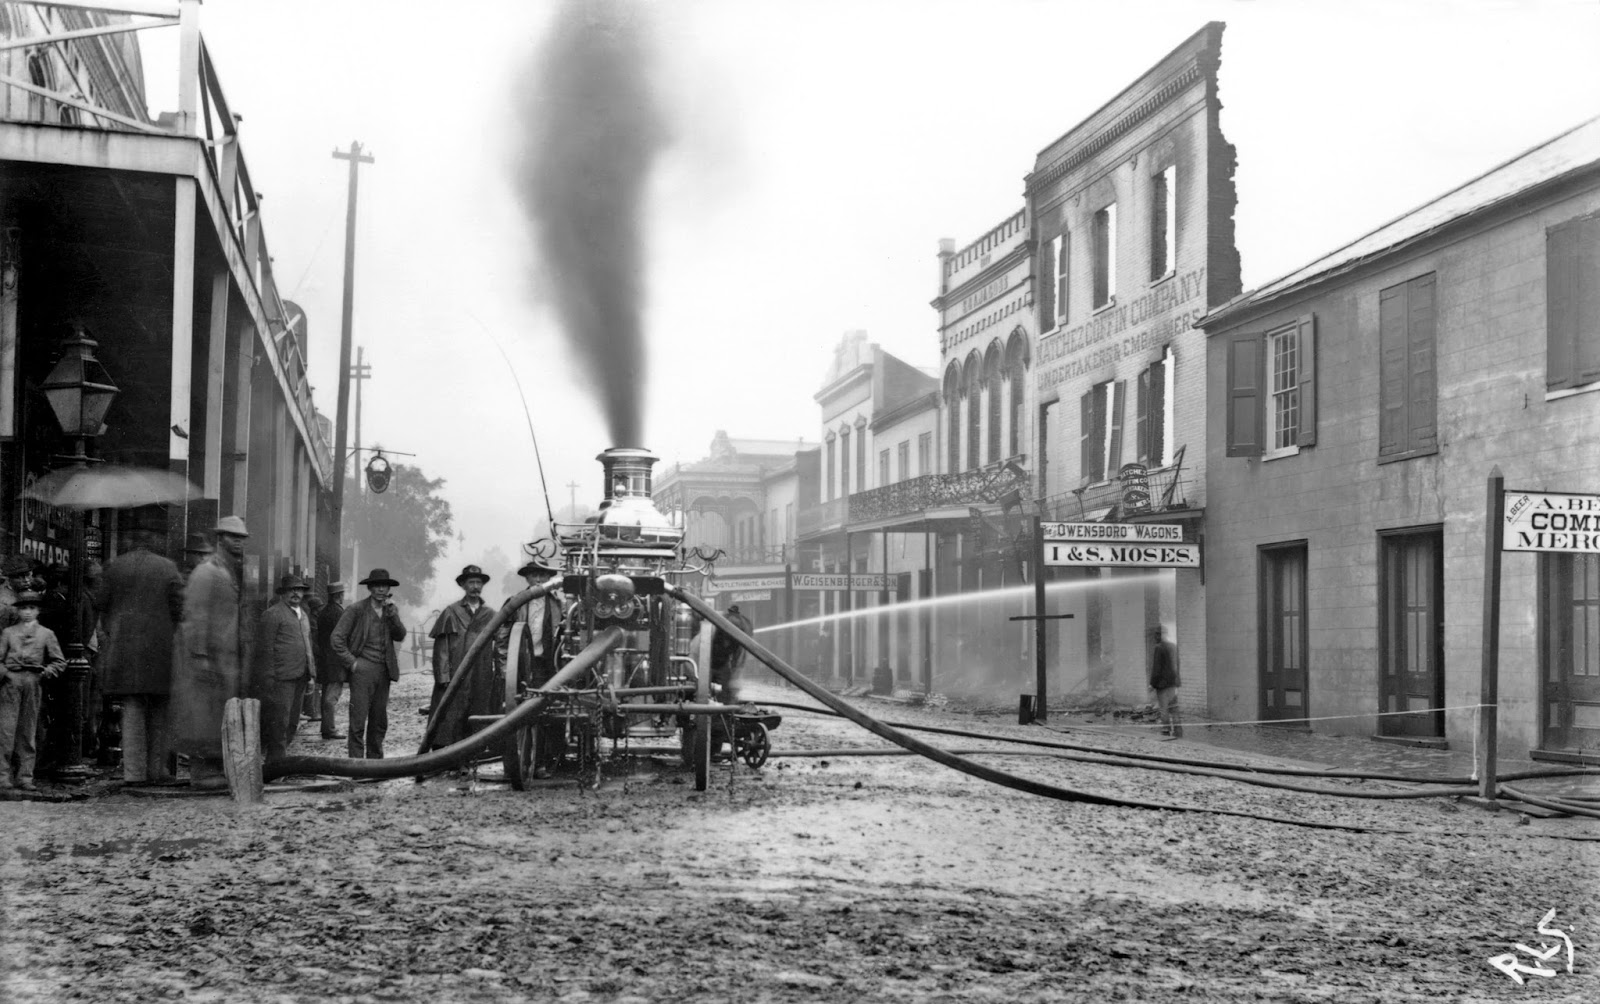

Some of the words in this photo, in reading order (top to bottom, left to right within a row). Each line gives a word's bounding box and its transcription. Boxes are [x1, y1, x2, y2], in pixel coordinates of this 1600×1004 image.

[1131, 267, 1205, 326] COMPANY
[1067, 546, 1084, 562] &
[1086, 546, 1105, 562] S.
[1110, 547, 1194, 563] MOSES.
